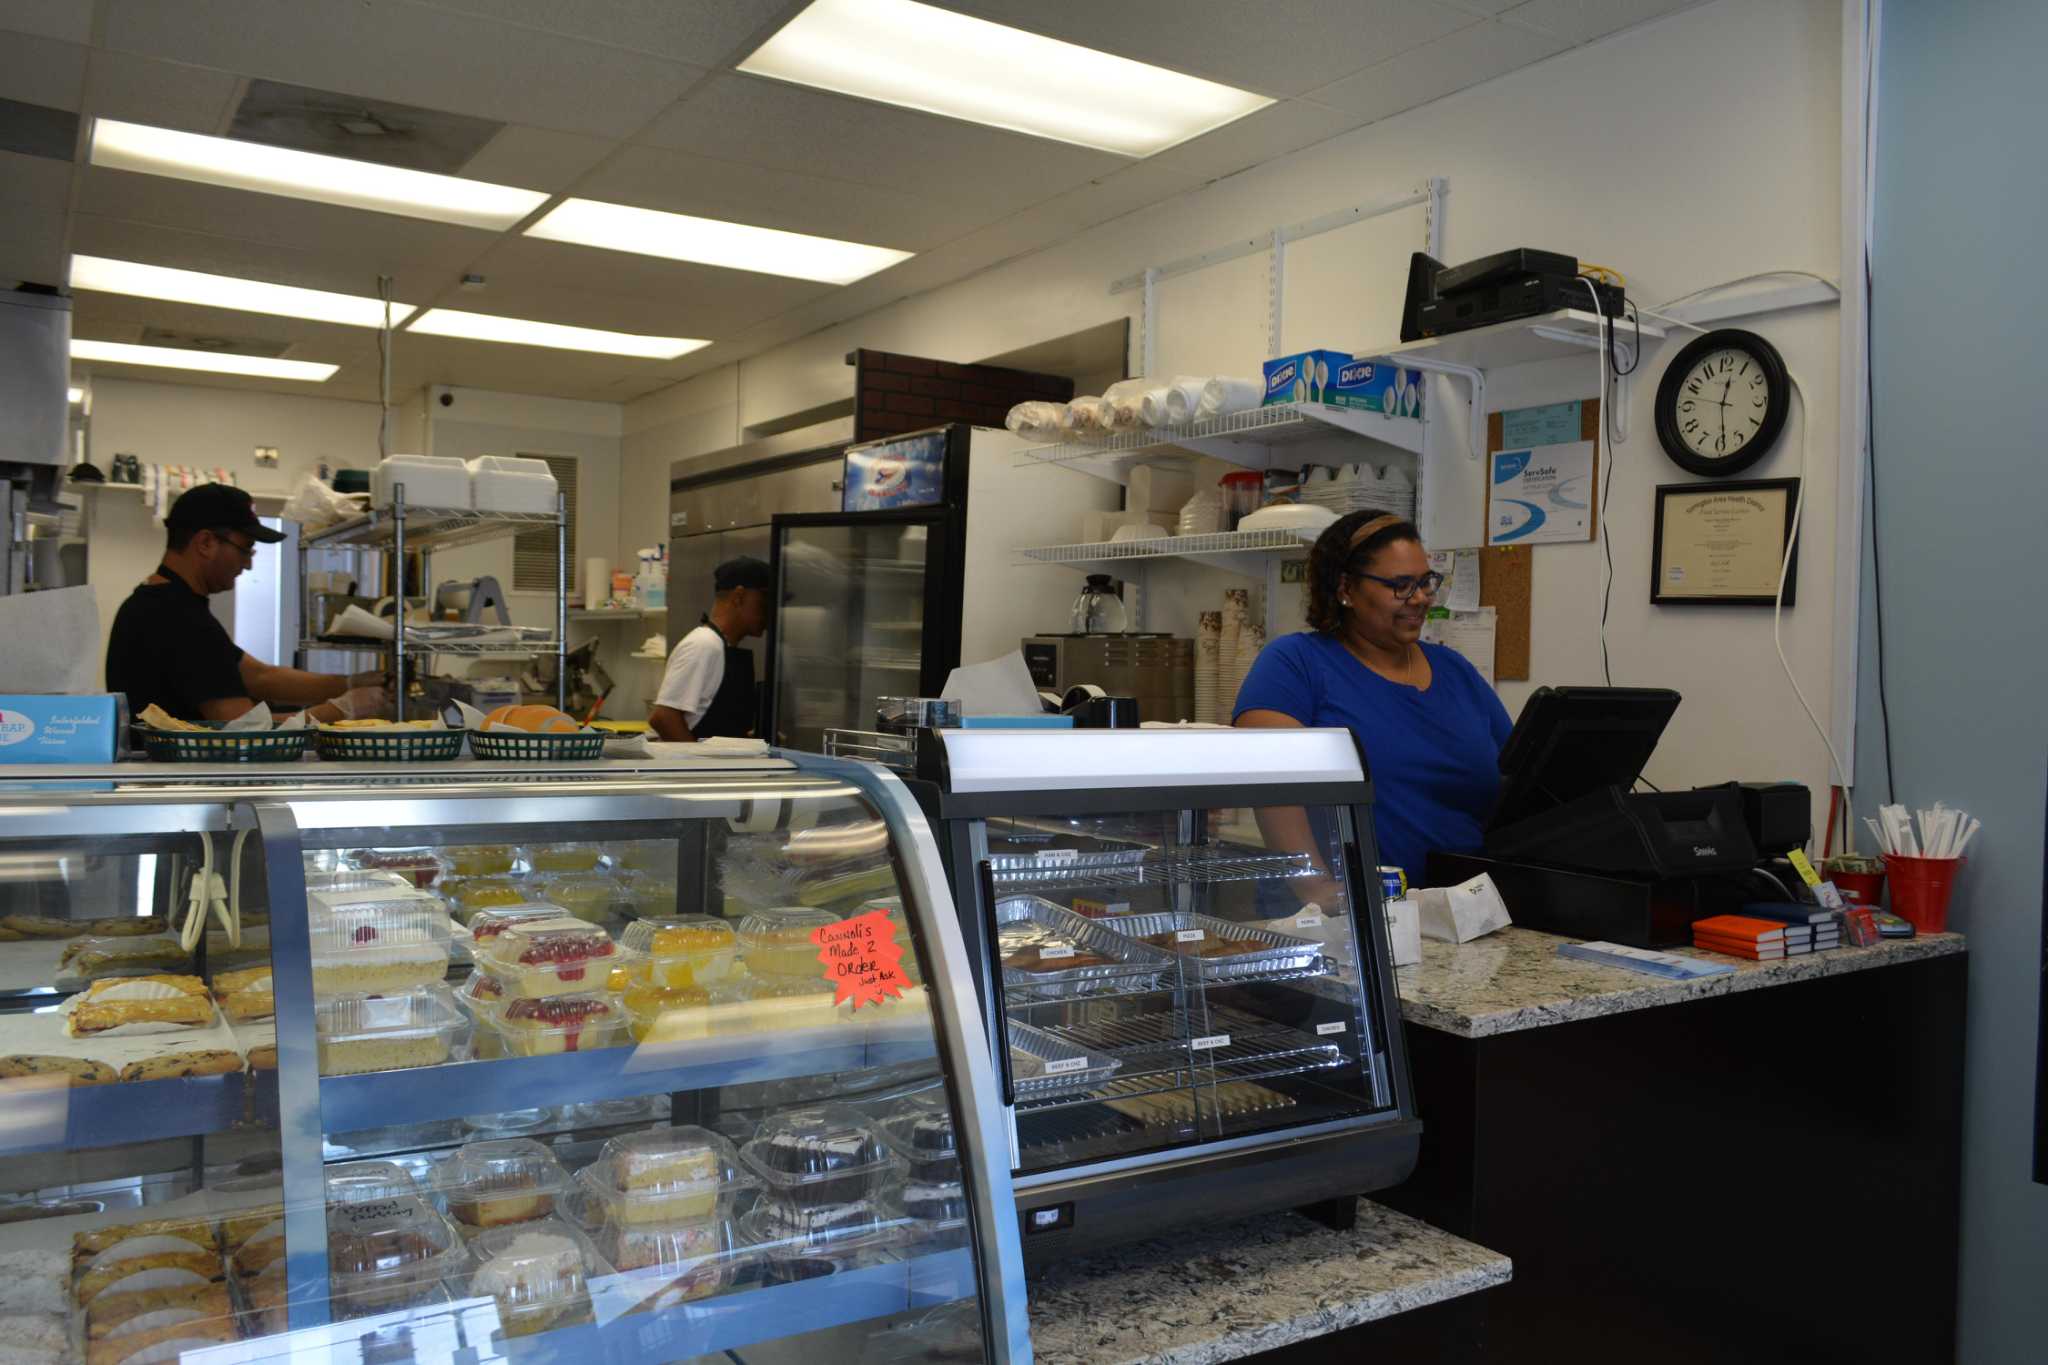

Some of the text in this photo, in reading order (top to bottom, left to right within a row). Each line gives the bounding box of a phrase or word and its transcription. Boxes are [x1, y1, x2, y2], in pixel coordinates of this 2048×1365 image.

[1703, 363, 1715, 380] 11
[1720, 356, 1733, 373] 12
[1739, 361, 1749, 375] 1
[1688, 377, 1702, 395] 10
[1749, 374, 1763, 390] 2
[1682, 400, 1696, 413] 9
[1685, 419, 1699, 433] 8
[1698, 431, 1710, 445] 7
[867, 940, 877, 952] 2
